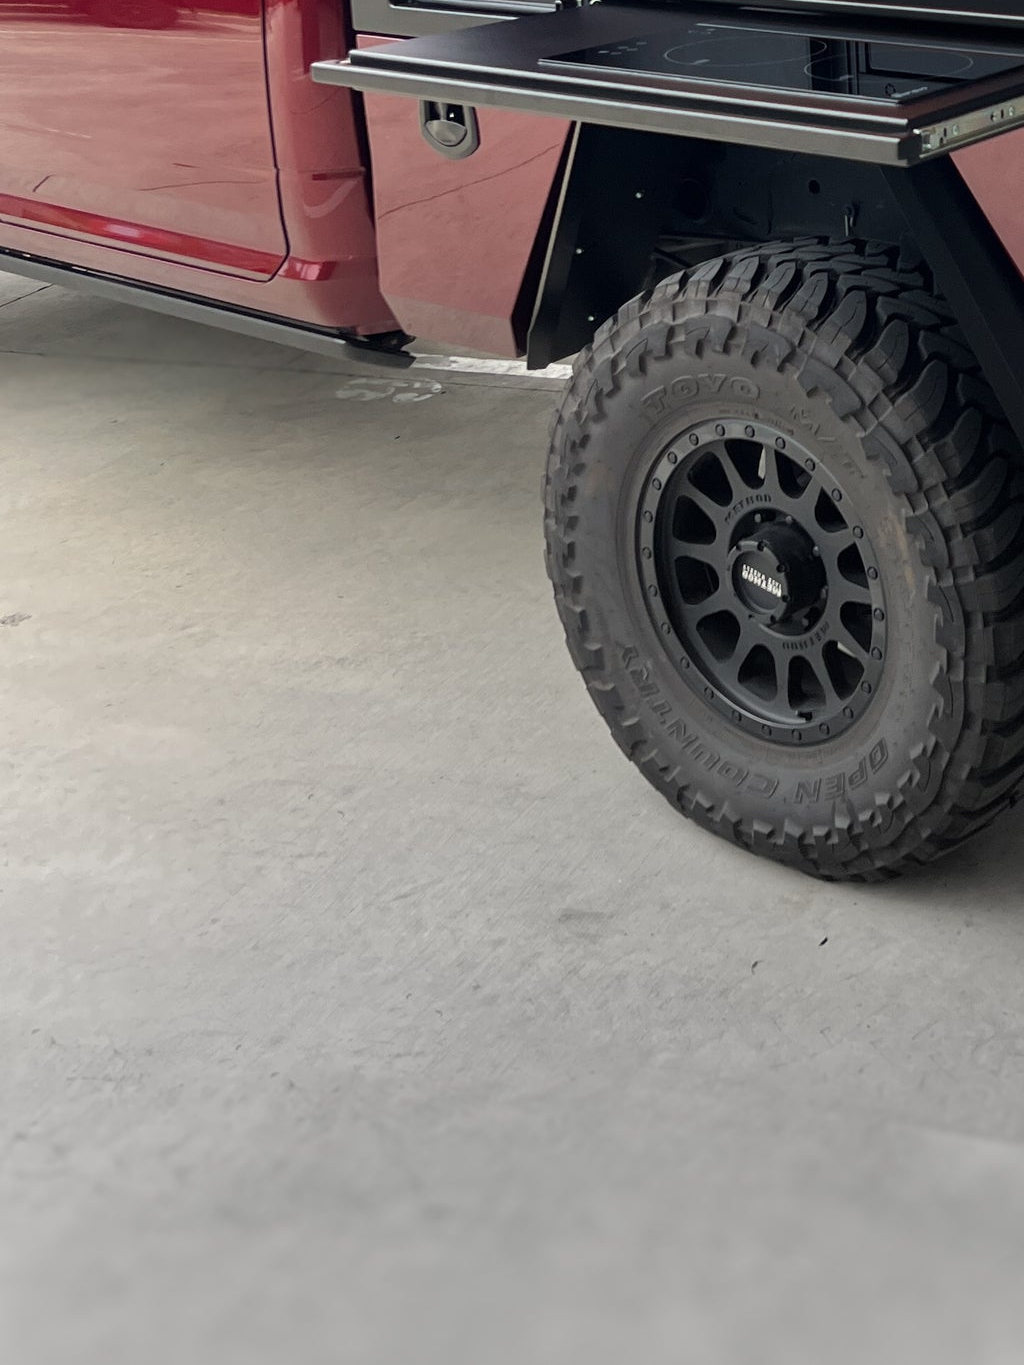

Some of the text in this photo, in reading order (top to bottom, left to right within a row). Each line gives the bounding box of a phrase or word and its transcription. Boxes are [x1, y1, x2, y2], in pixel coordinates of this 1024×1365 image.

[640, 373, 761, 413] TOYO
[615, 641, 889, 804] OPEN COUNTRY
